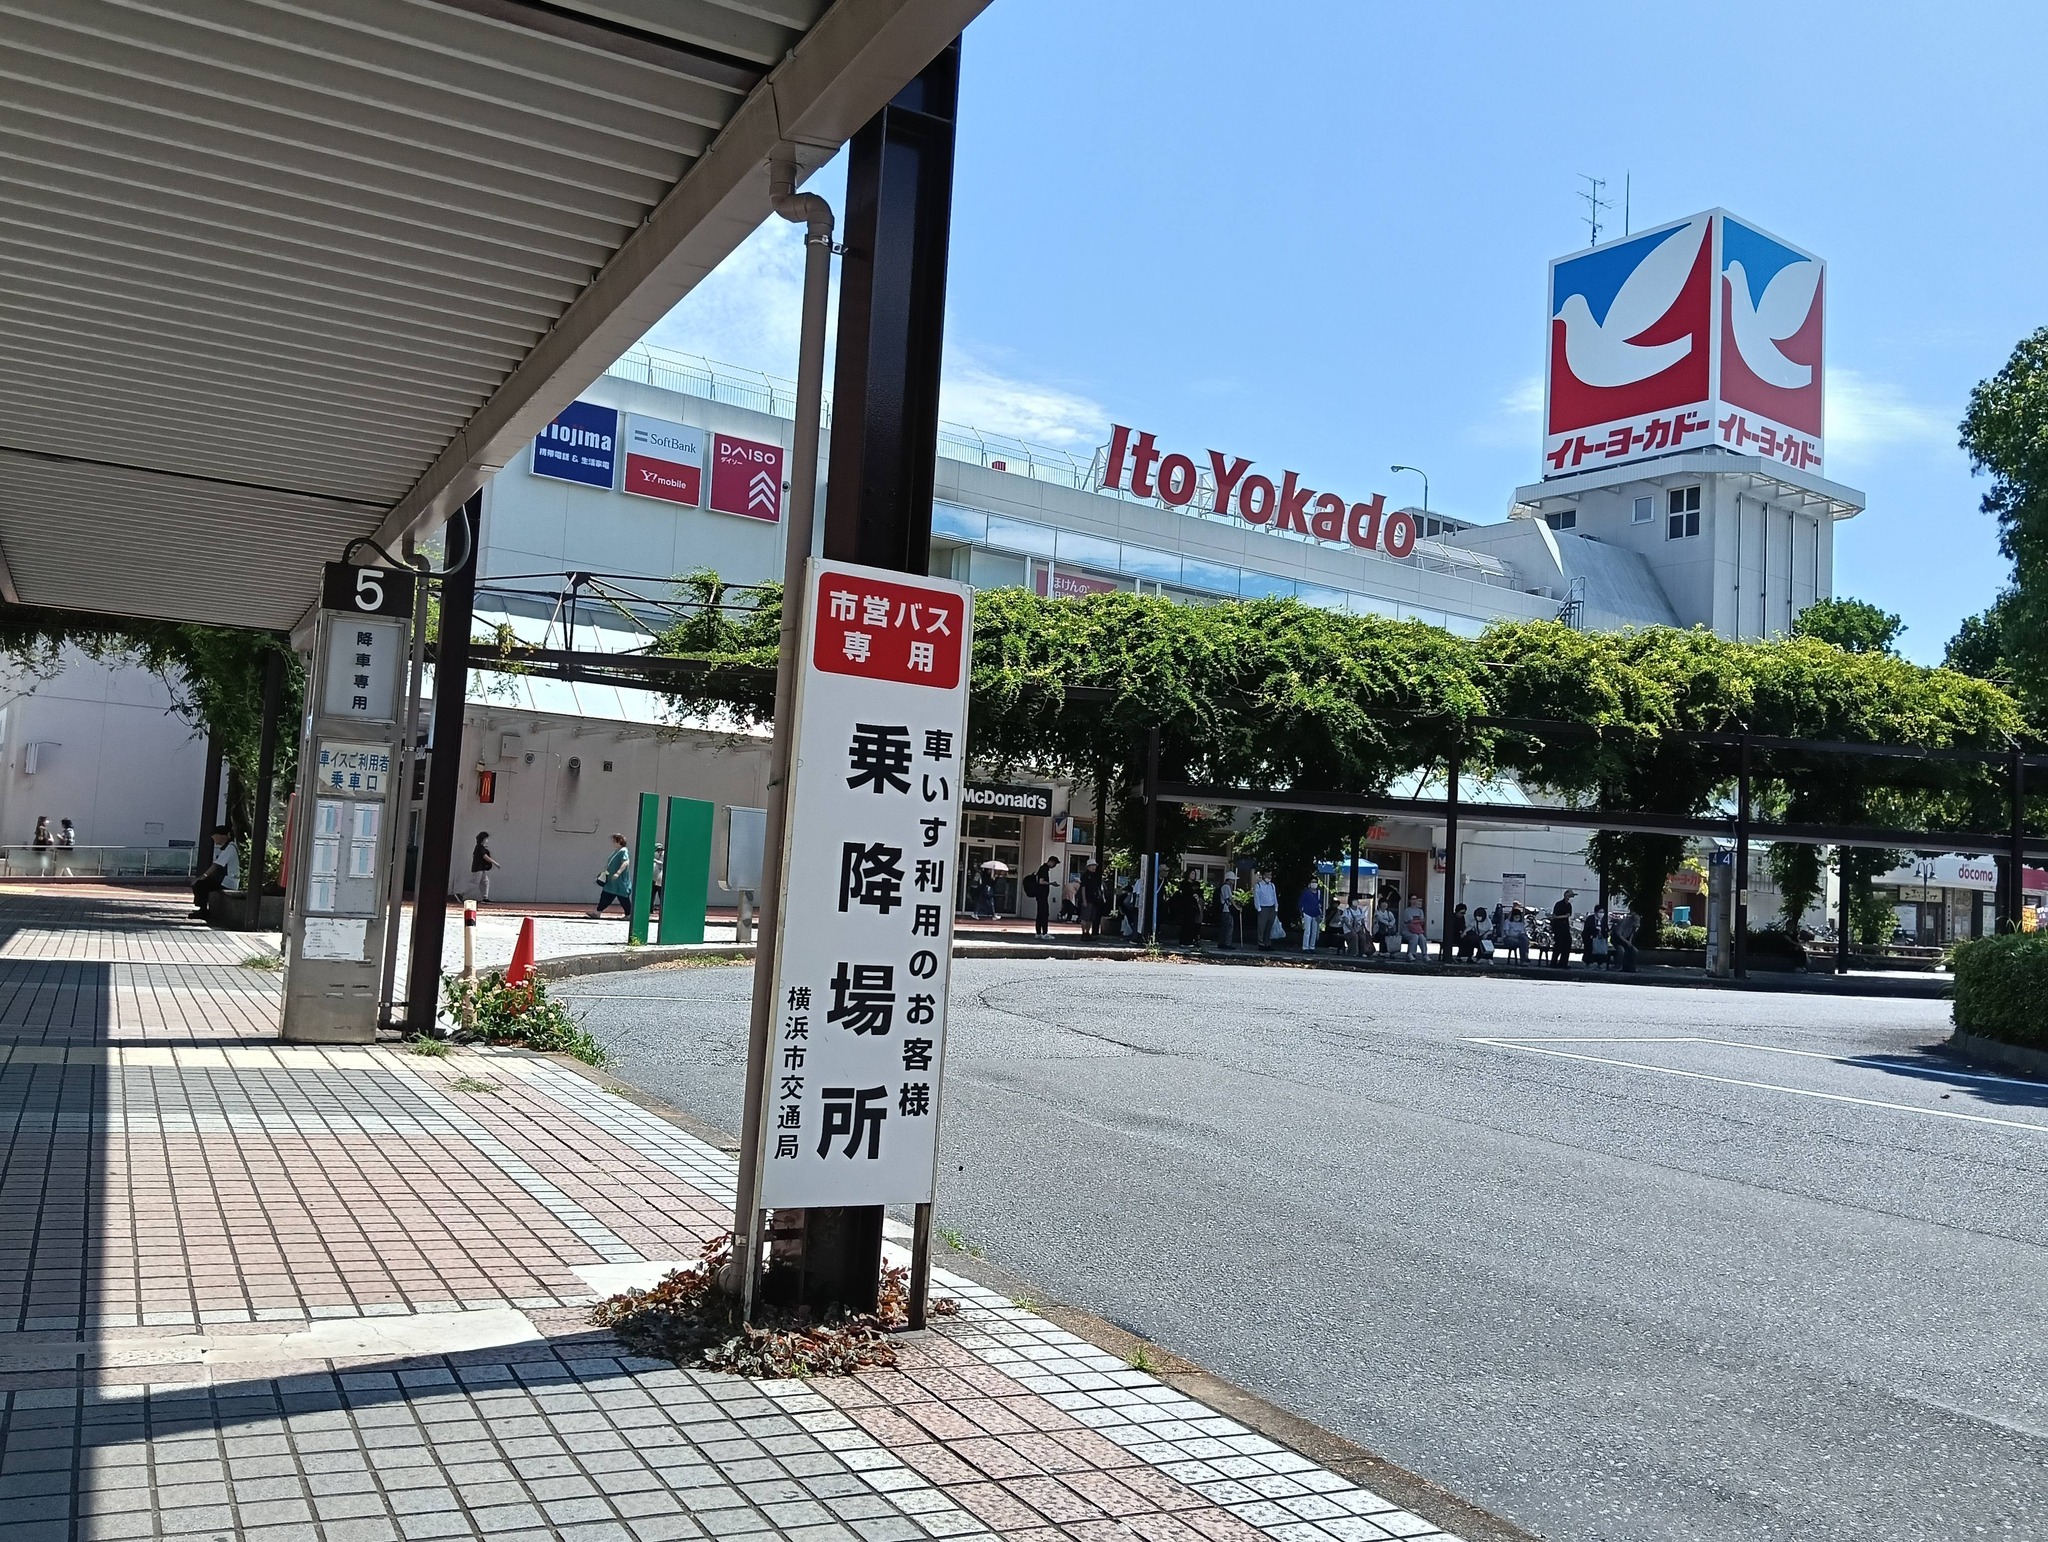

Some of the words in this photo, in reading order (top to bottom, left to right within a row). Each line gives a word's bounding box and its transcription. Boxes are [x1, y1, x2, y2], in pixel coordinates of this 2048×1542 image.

[650, 434, 696, 454] SoftBank
[721, 443, 776, 465] DAISO
[721, 456, 743, 465] ダイソー
[1547, 411, 1710, 469] イトーヨーカドー
[1718, 413, 1821, 469] イトーヨーカドー
[1101, 423, 1197, 506] Ito
[1206, 448, 1417, 559] Yokado
[355, 568, 384, 611] 5
[1054, 577, 1090, 594] ほけんの
[829, 590, 951, 637] 市営バス
[352, 631, 373, 711] 降車専用
[842, 631, 935, 673] 専用
[320, 749, 389, 773] 車イスご利用者
[331, 771, 378, 791] 乗車口
[962, 787, 1047, 810] McDonald's
[1722, 853, 1731, 865] 4
[1958, 864, 1993, 882] docomo
[816, 722, 912, 1160] 乗降場所
[898, 728, 953, 1117] 車いす利用のお客様
[773, 985, 812, 1160] 横浜市交通局
